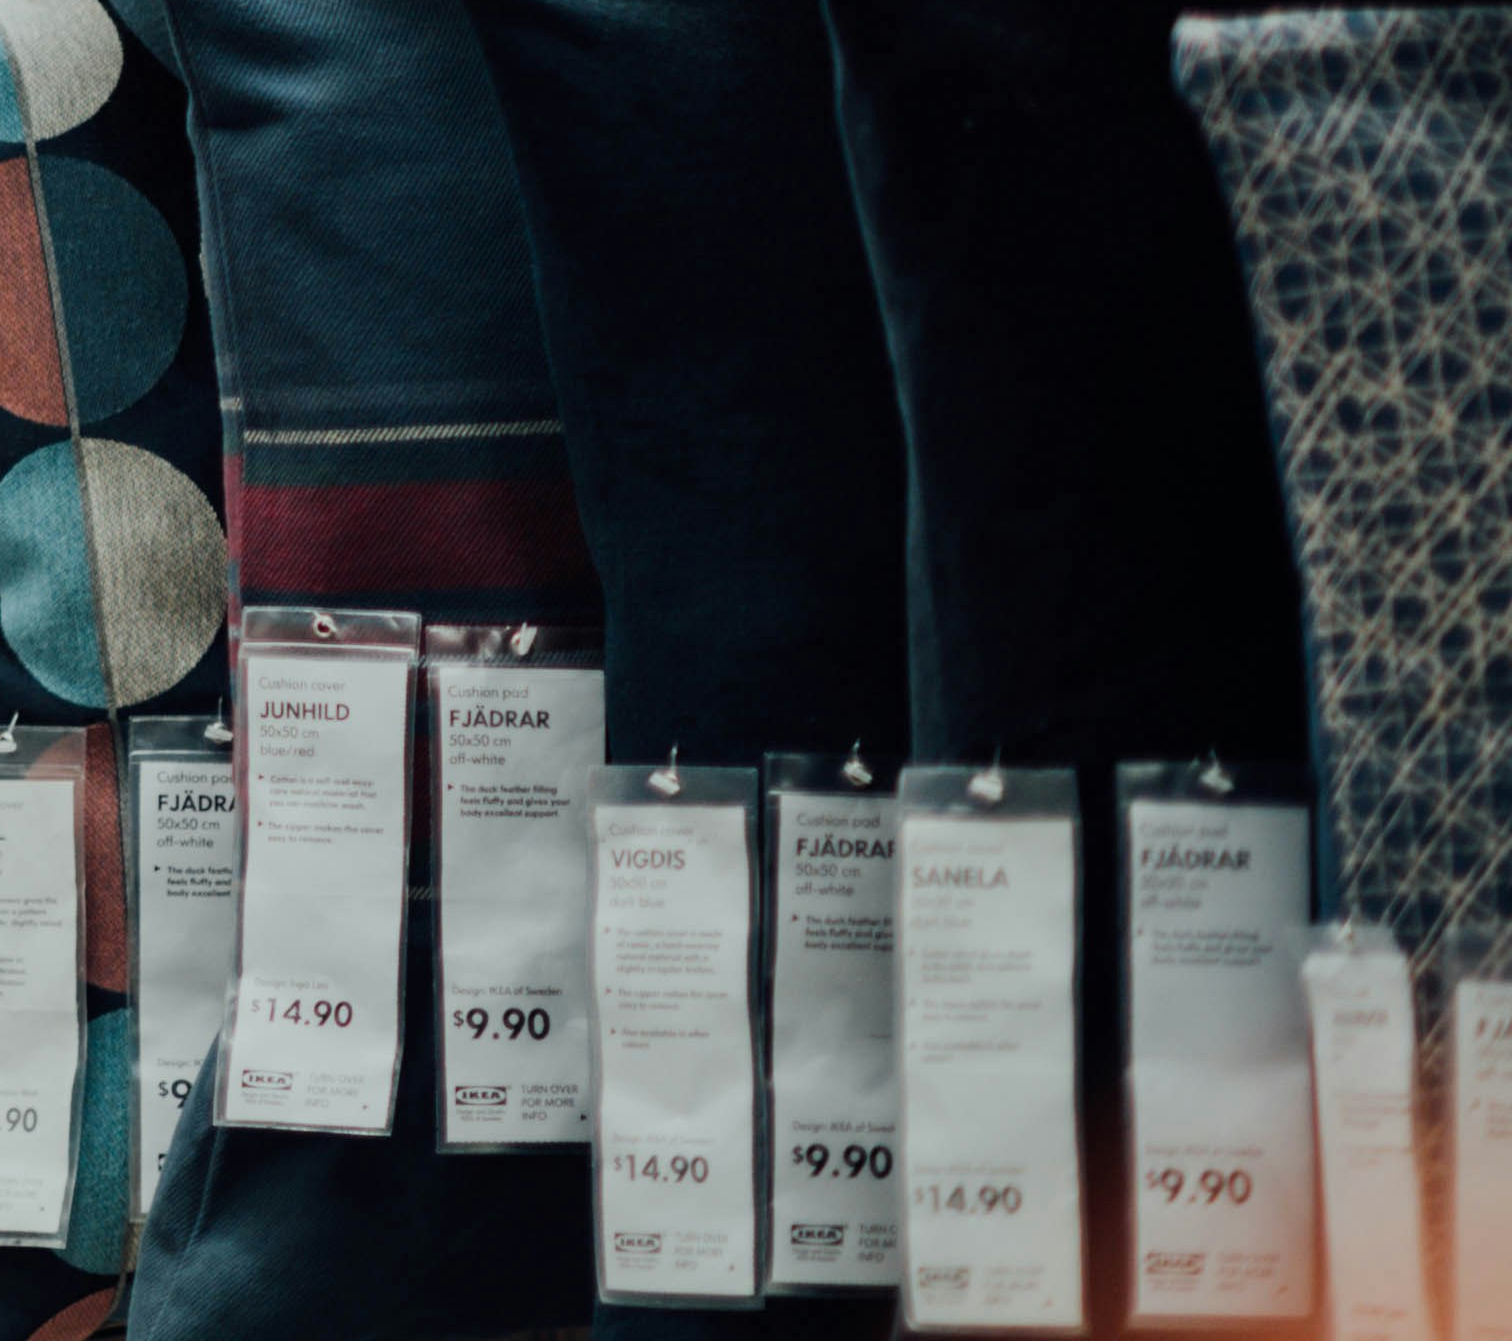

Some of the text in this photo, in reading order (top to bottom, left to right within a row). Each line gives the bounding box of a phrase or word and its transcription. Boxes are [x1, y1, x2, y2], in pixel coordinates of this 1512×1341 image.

[259, 677, 346, 691] Cushion cover
[448, 685, 529, 701] Cushion pad
[260, 701, 350, 720] JUNHILD
[449, 705, 550, 729] FJÄDRAR
[449, 733, 511, 747] 50x50 cm
[449, 752, 506, 765] off-white
[157, 771, 208, 783] Cushion
[157, 818, 220, 829] 50x50 cm
[157, 837, 214, 848] off-white
[612, 849, 686, 869] VIGDIS
[911, 867, 1010, 889] SANELA
[251, 997, 353, 1027] $14.90
[454, 1007, 550, 1041] $9.90
[521, 1085, 579, 1094] TURN OVER
[521, 1098, 575, 1107] FOR MORE
[522, 1111, 547, 1120] INFO
[614, 1154, 709, 1183] $14.90
[793, 1143, 893, 1179] $9.90
[1146, 1168, 1253, 1205] $9.90
[915, 1184, 1022, 1214] $14.90
